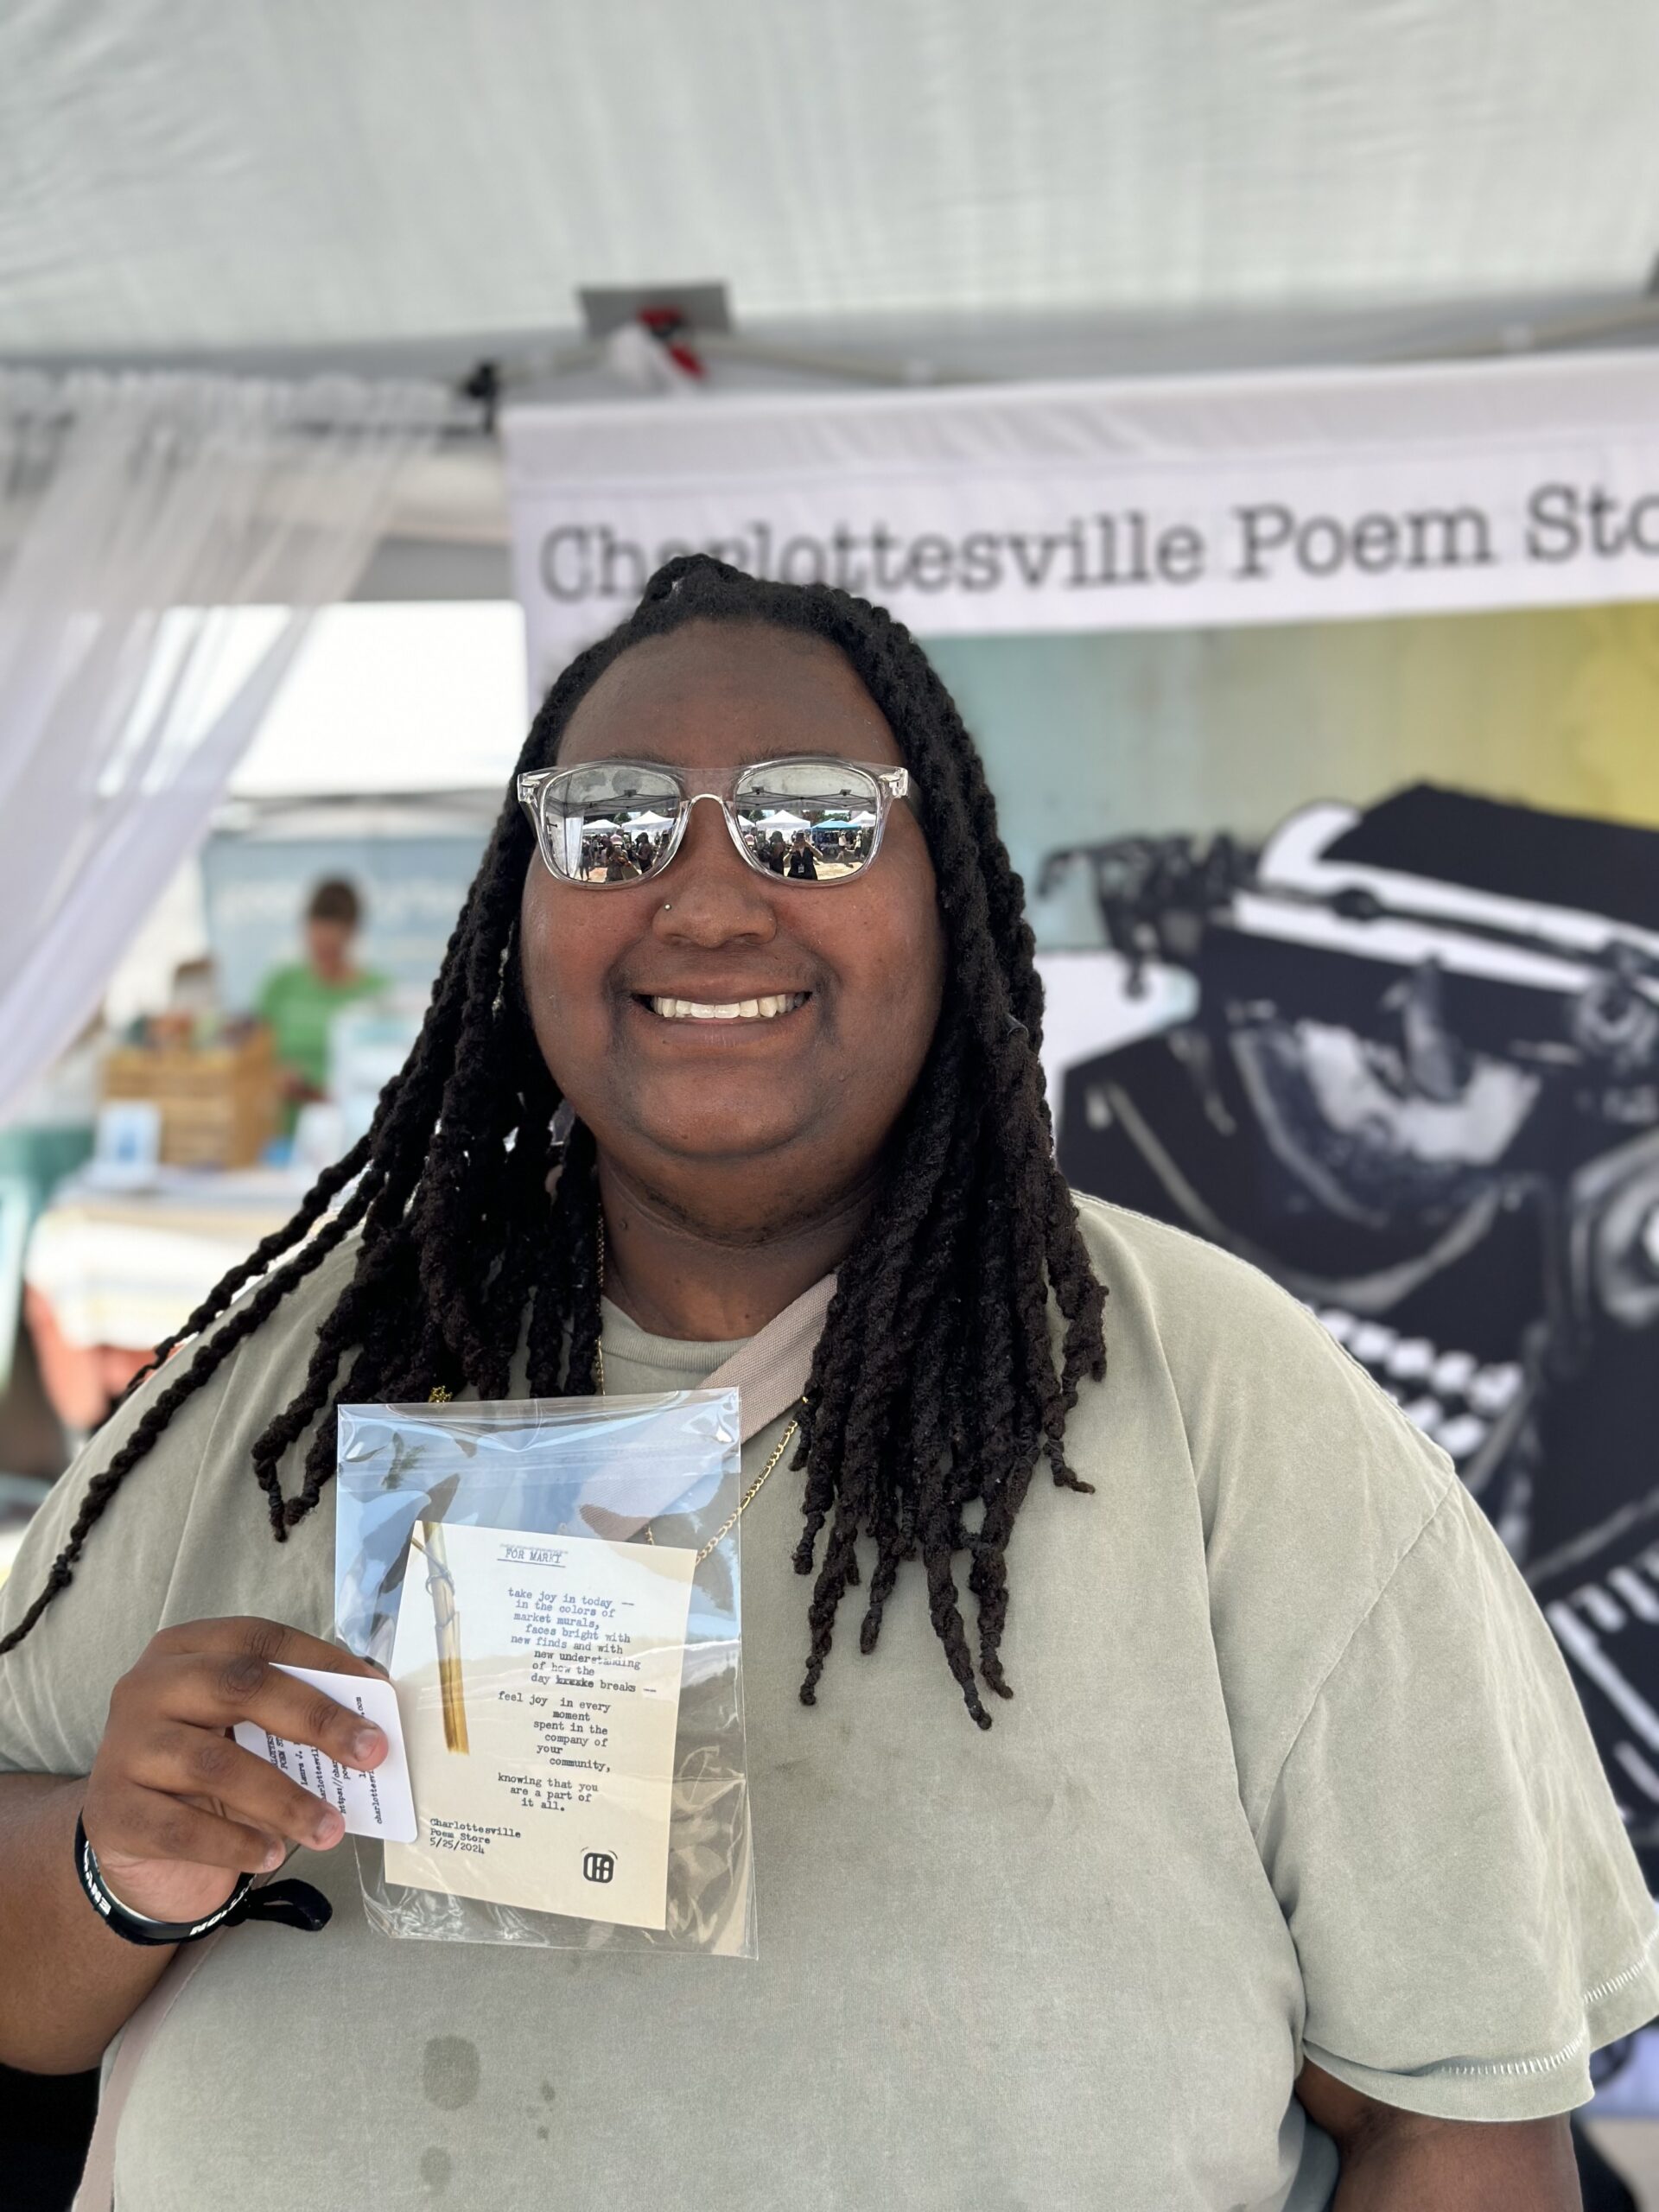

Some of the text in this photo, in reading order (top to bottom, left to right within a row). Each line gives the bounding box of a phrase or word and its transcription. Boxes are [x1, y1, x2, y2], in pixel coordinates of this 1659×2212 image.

[1230, 501, 1497, 582] Poem
[505, 1548, 524, 1560] FOR
[508, 1587, 532, 1599] take
[538, 1592, 557, 1603] joy
[563, 1593, 575, 1603] in
[582, 1596, 613, 1609] today
[516, 1600, 615, 1618] in the colors of
[513, 1612, 600, 1630] market murals,
[525, 1624, 631, 1643] faces bright with
[511, 1635, 623, 1655] new finds and with
[534, 1650, 554, 1660] new
[532, 1662, 546, 1670] of
[576, 1665, 594, 1676] the
[531, 1673, 550, 1686] day
[600, 1679, 637, 1693] breaks
[498, 1691, 613, 1713] feel joy in every
[552, 1711, 591, 1721] moment
[533, 1720, 608, 1735] spent in the
[544, 1733, 608, 1747] company of
[537, 1745, 563, 1754] your
[550, 1758, 611, 1773] community,
[498, 1772, 599, 1793] knowing that you
[510, 1786, 529, 1796] are
[547, 1790, 573, 1801] part
[578, 1793, 592, 1802] of
[521, 1798, 565, 1812] it all.
[429, 1818, 521, 1839] Charlottesville
[429, 1827, 491, 1845] Poem Store
[429, 1837, 485, 1854] 5/25/2024
